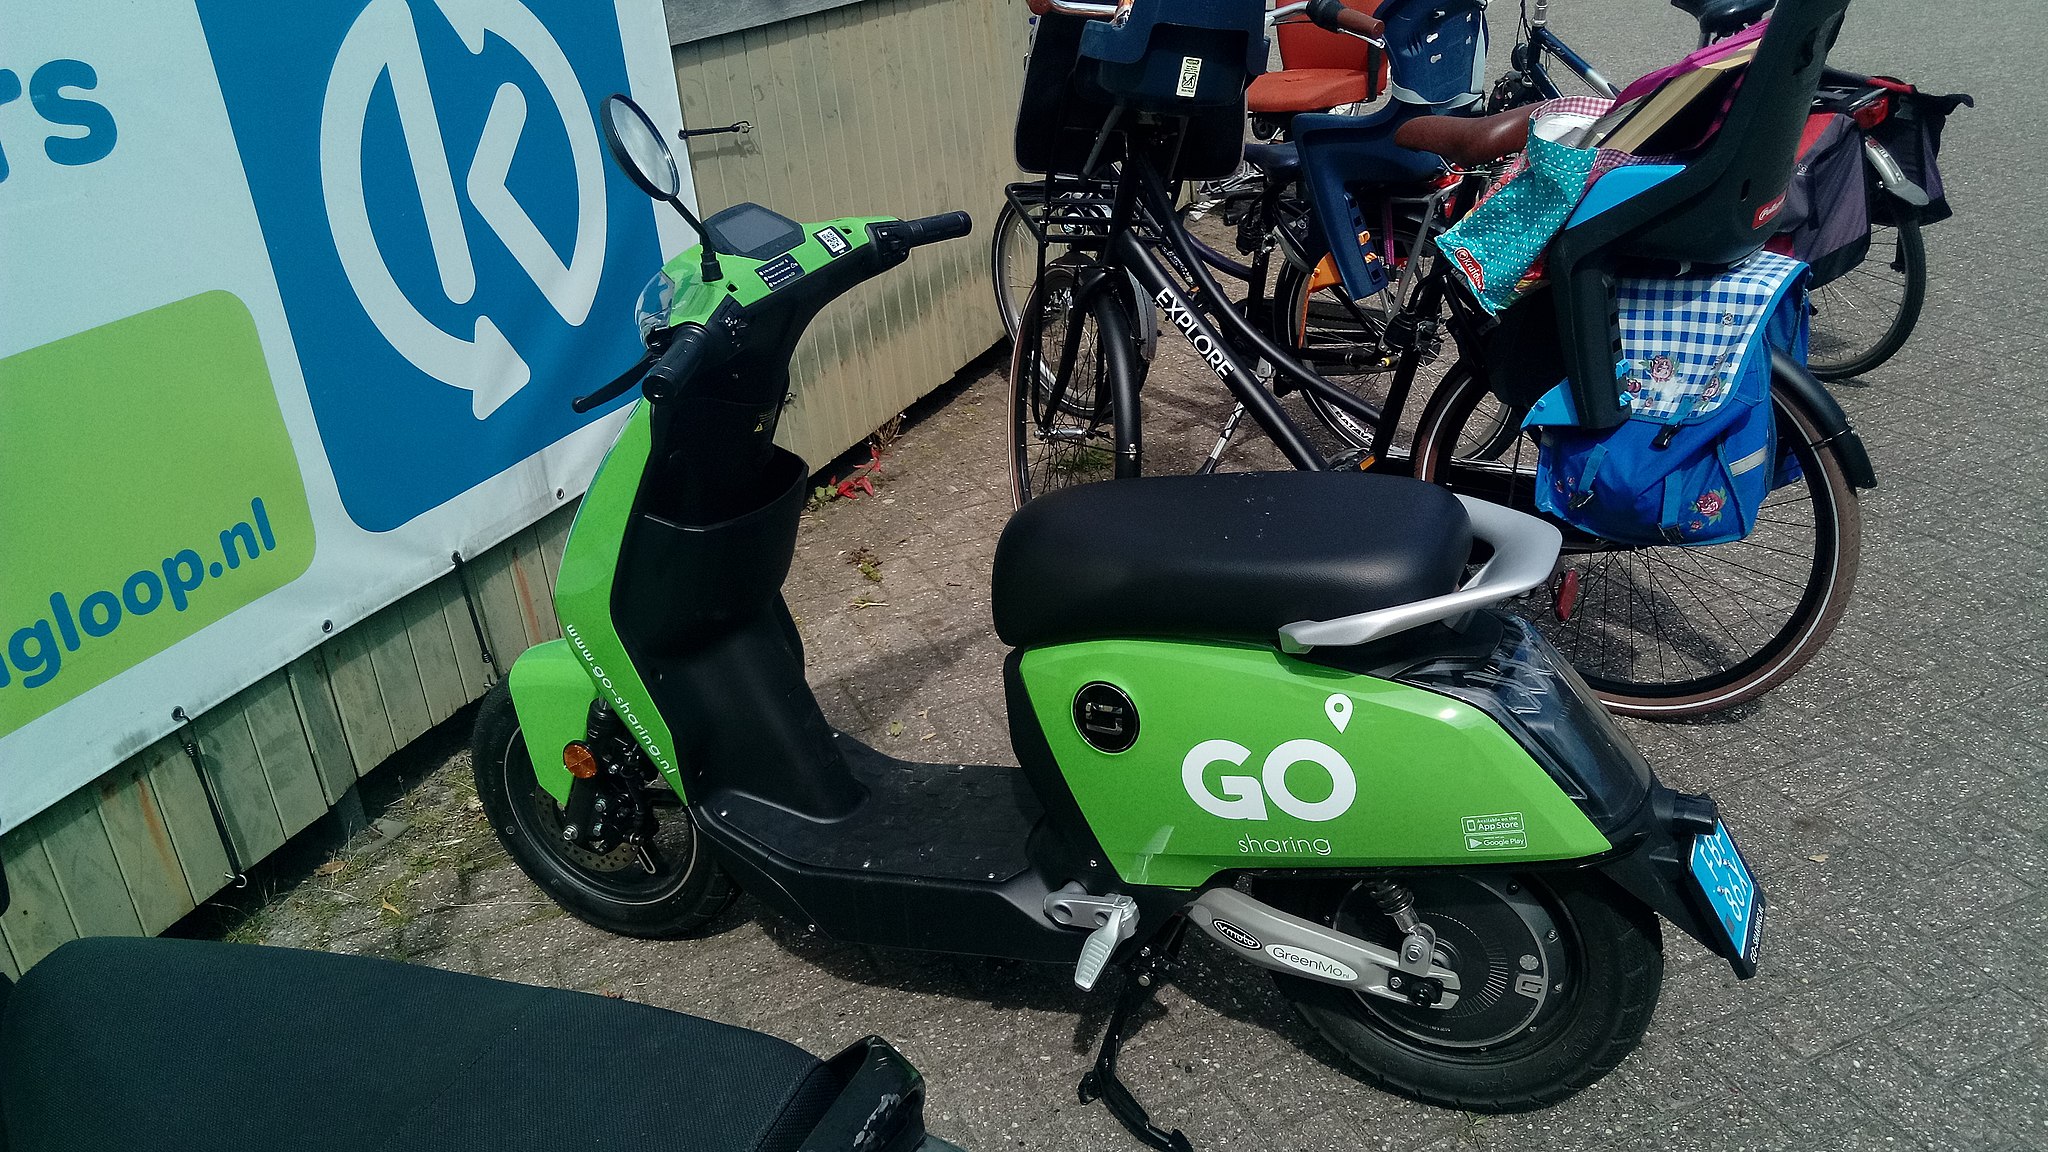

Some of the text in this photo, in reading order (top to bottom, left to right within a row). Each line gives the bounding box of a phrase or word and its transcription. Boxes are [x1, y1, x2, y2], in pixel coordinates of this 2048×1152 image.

[1155, 287, 1235, 379] EXPLORE
[0, 497, 277, 689] gloop.nl
[566, 624, 677, 774] www.go-sharing.nl
[1181, 738, 1357, 822] GO
[1238, 833, 1332, 856] sharing
[1478, 821, 1519, 831] App Store
[1483, 839, 1509, 847] Google
